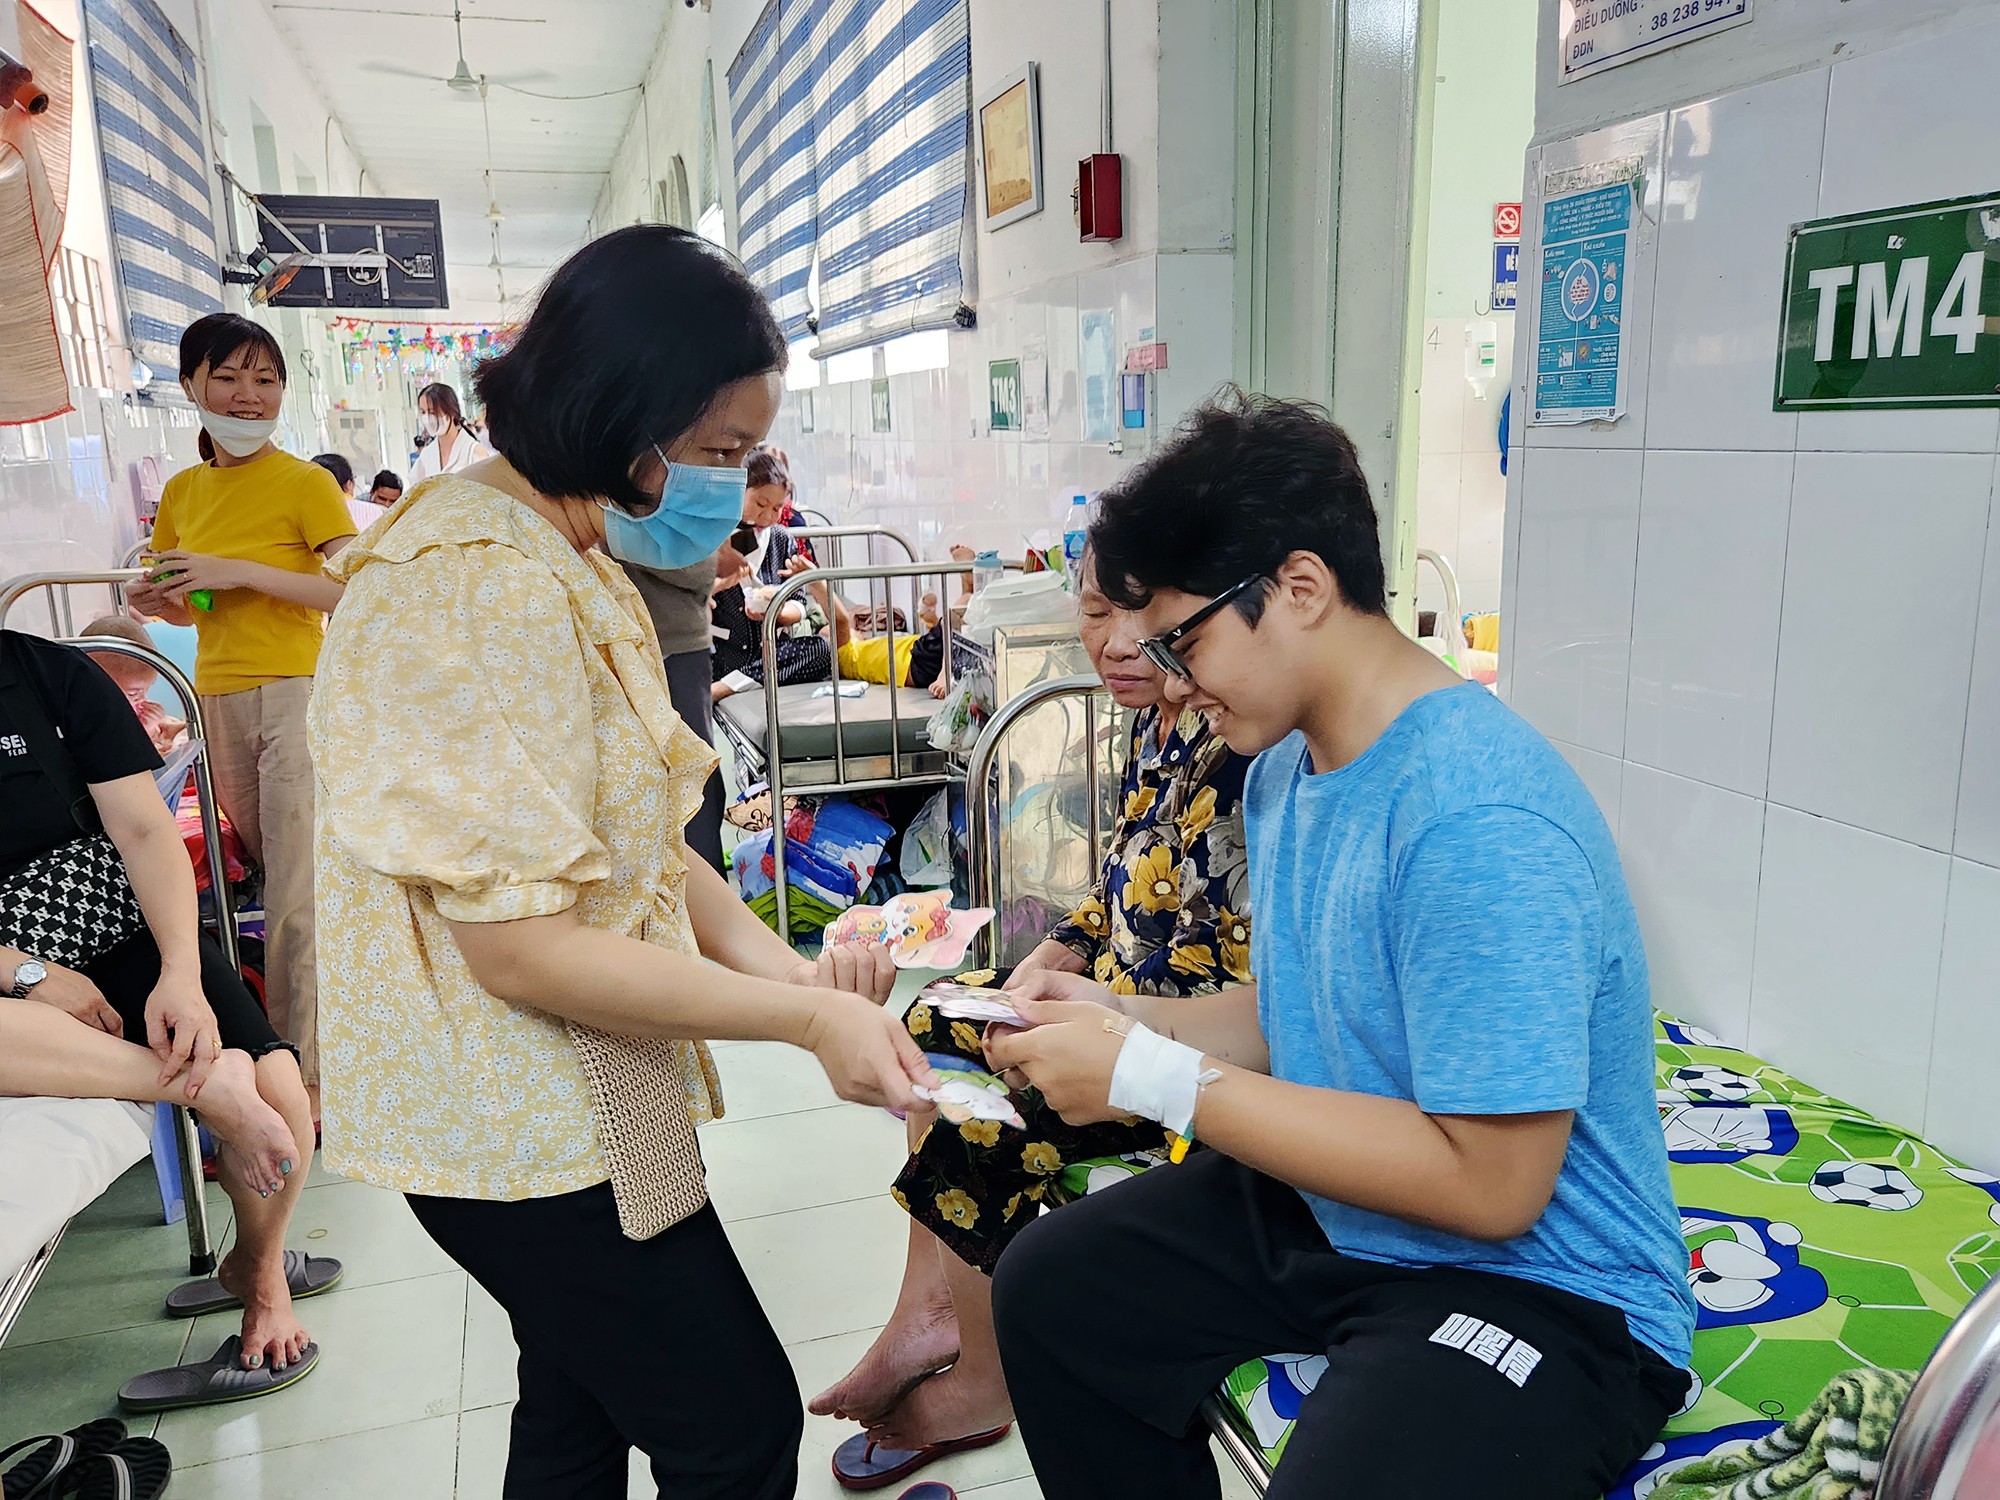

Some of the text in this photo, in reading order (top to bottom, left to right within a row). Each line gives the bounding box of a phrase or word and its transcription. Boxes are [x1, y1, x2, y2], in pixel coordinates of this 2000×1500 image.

[1573, 39, 1594, 60] ĐDN
[1651, 12, 1668, 31] 38
[1672, 1, 1700, 24] 238
[1807, 250, 1986, 363] TM4
[992, 375, 1017, 414] TM3
